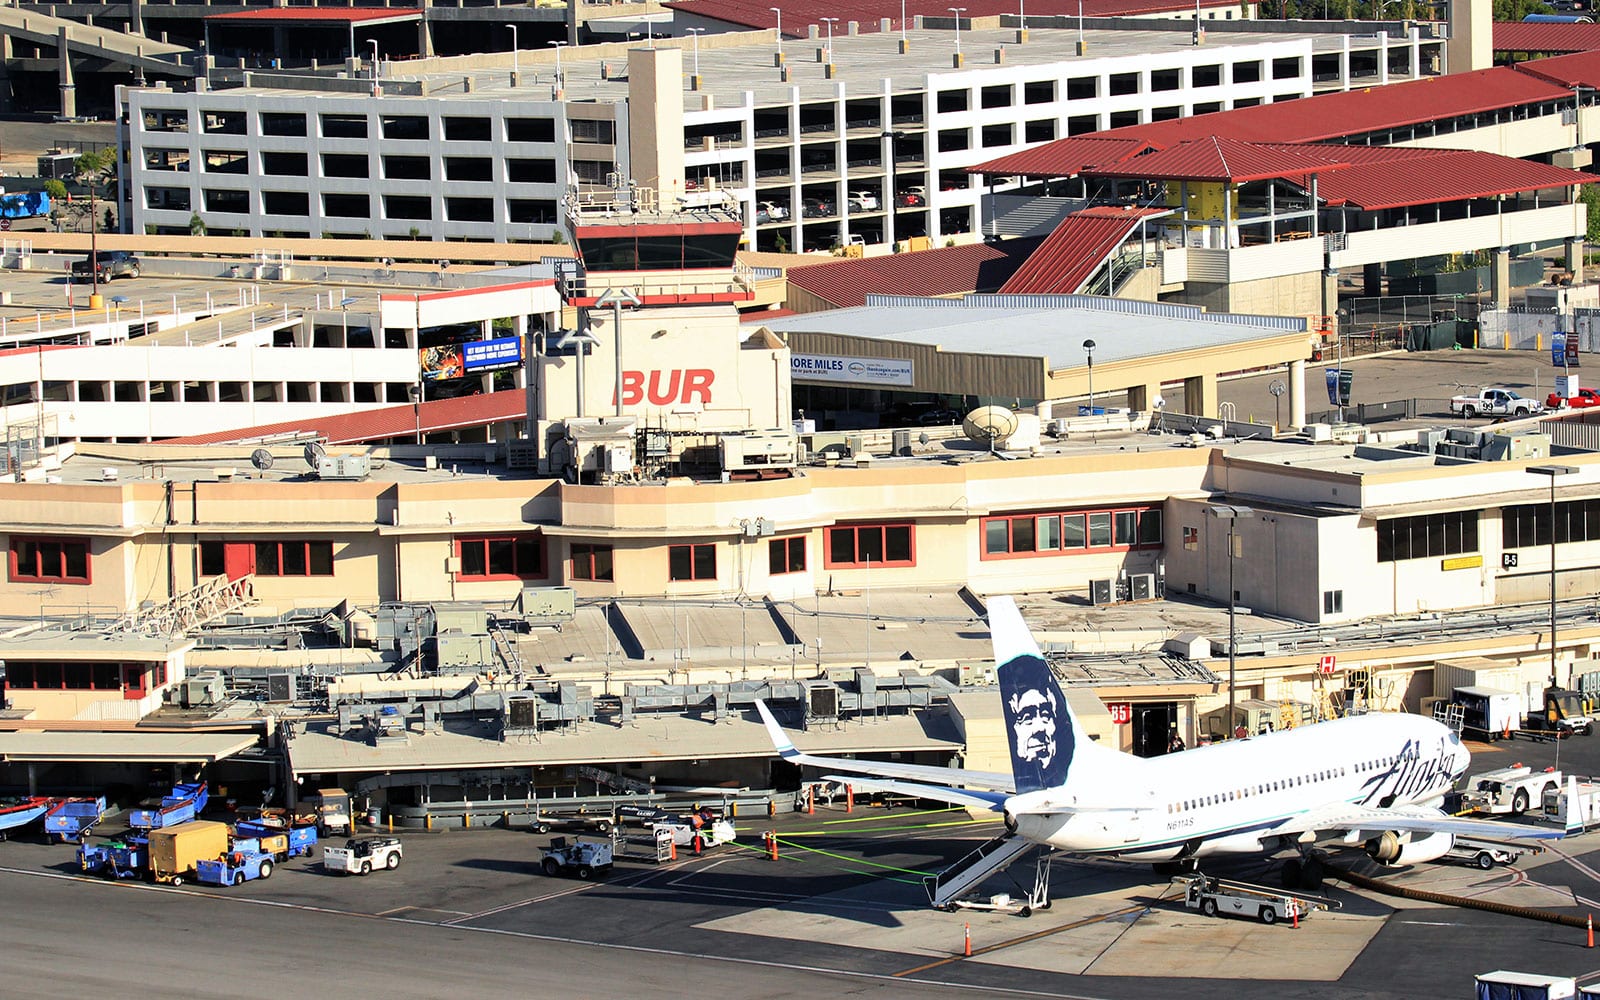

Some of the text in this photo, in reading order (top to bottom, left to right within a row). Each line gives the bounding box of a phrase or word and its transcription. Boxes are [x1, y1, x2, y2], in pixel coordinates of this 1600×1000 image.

[791, 357, 813, 369] ORE
[815, 359, 843, 370] MILES
[611, 369, 715, 405] BUR
[1482, 402, 1493, 411] 99
[1504, 554, 1517, 566] B-5
[1111, 705, 1126, 721] B5
[1358, 737, 1456, 806] Alaska
